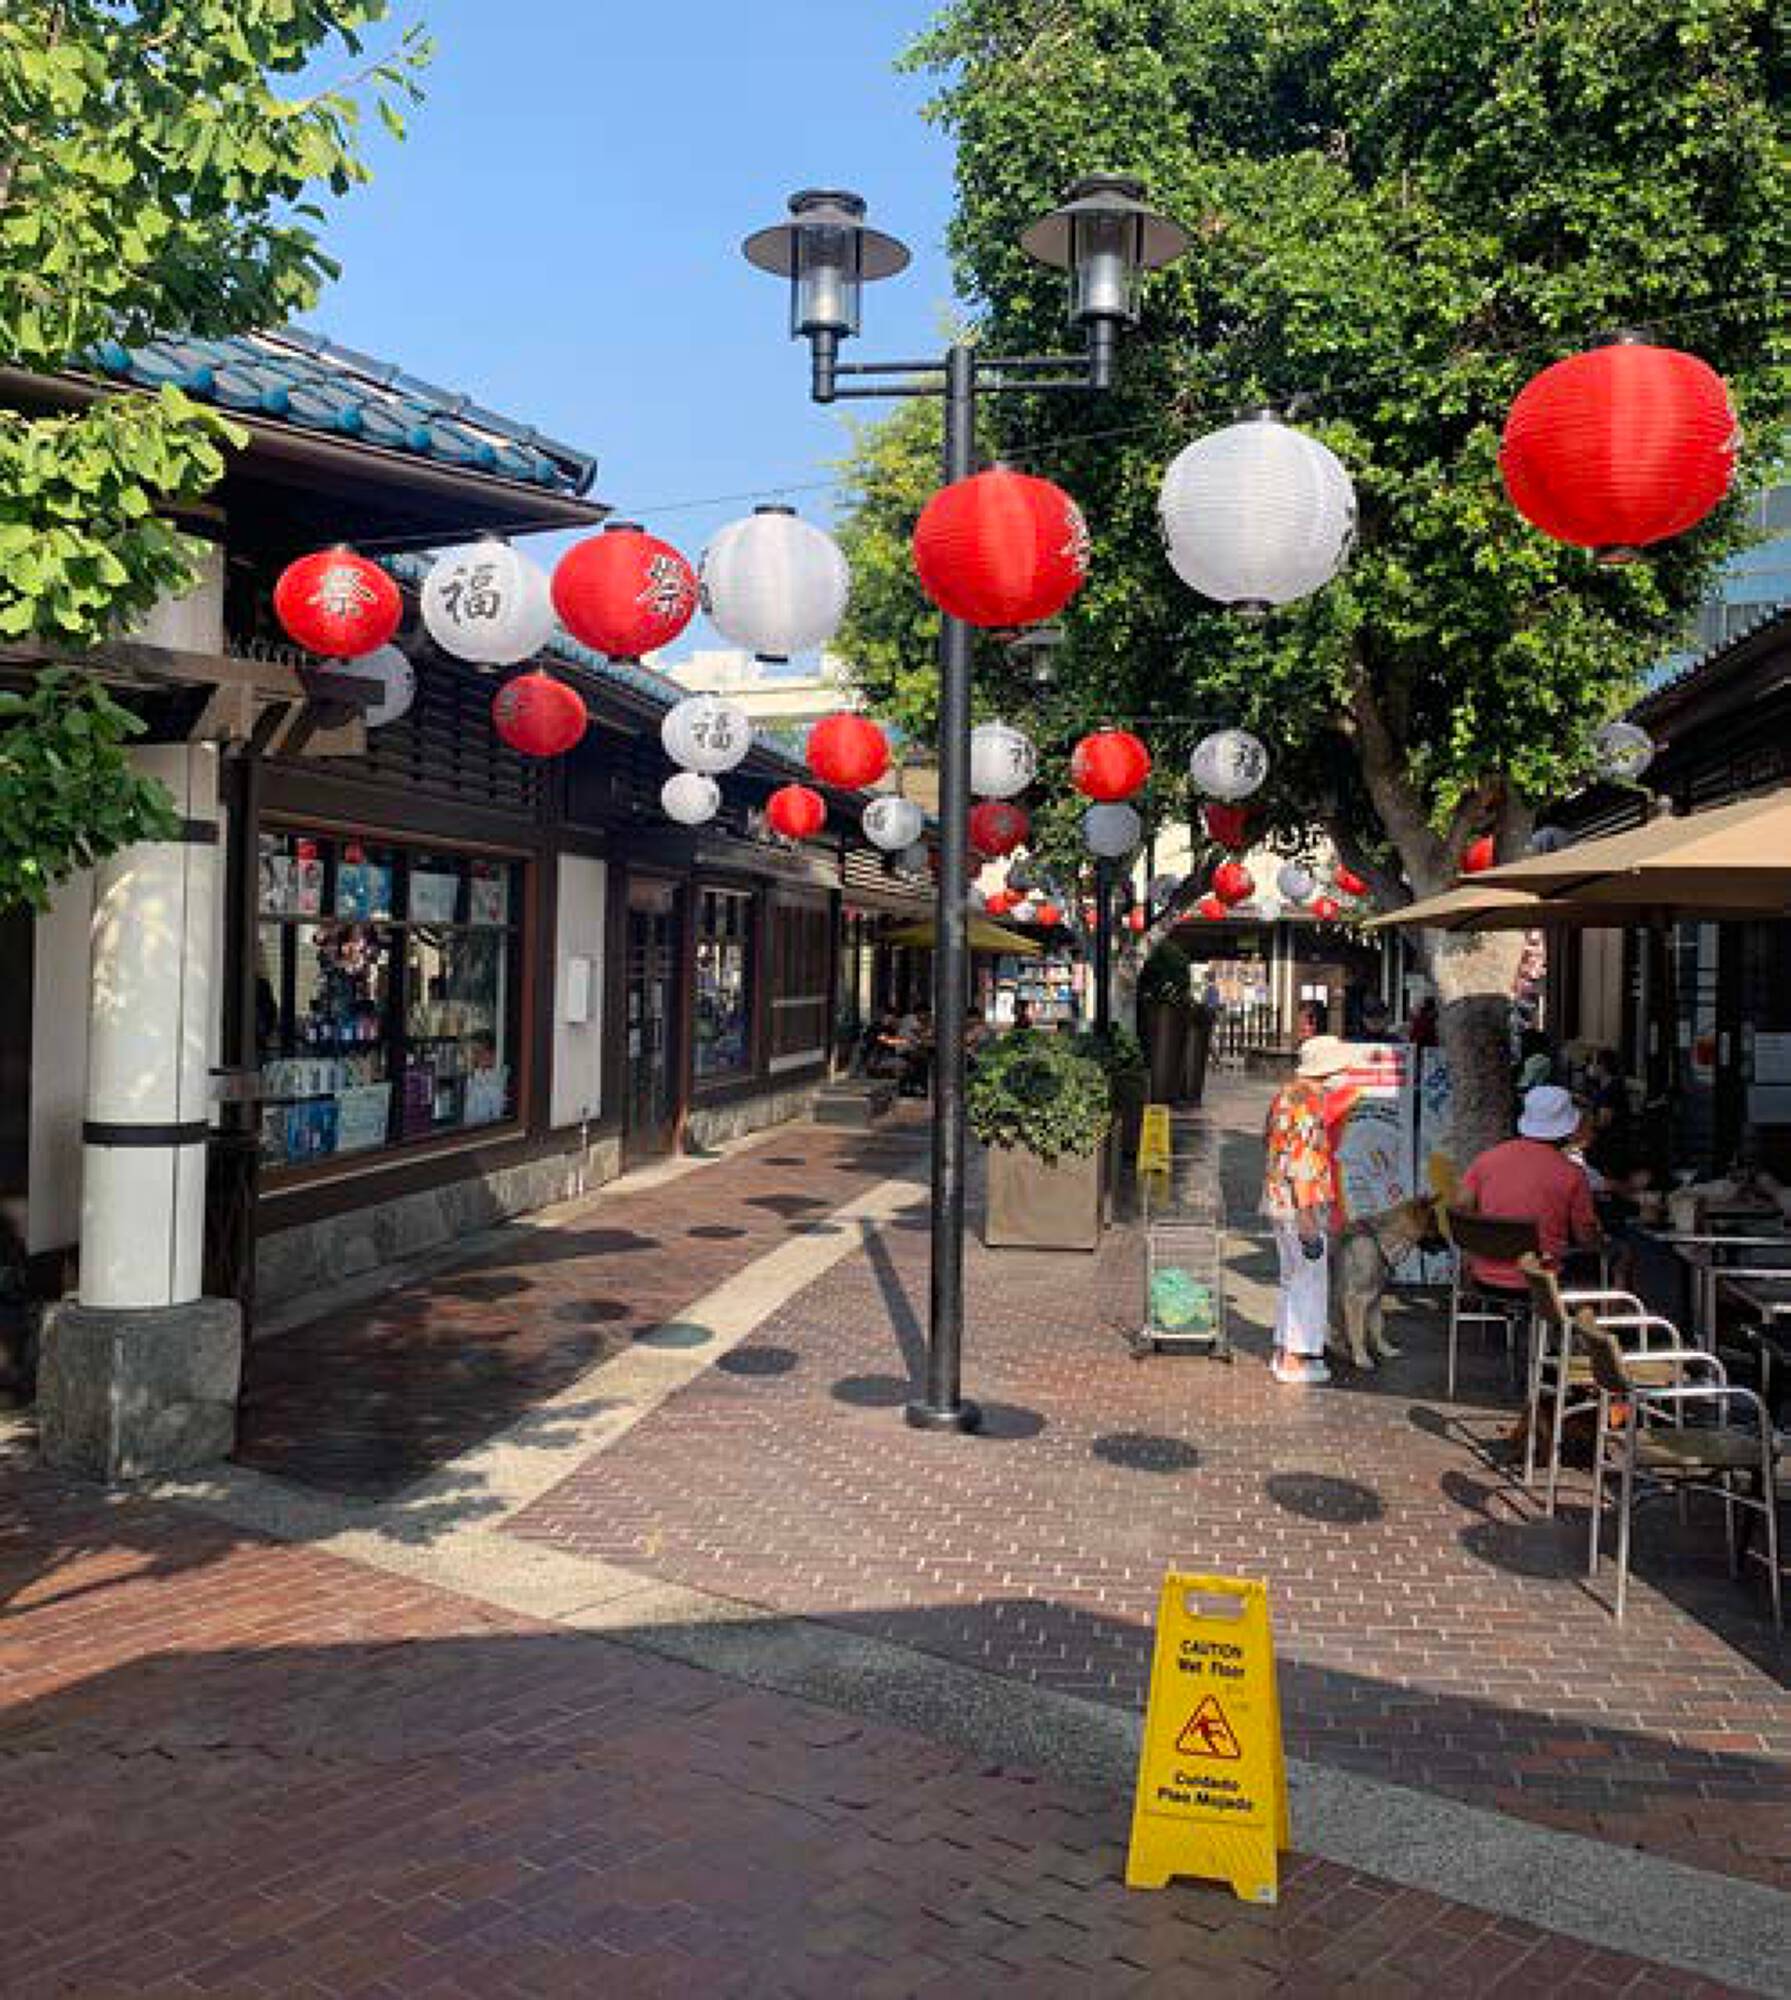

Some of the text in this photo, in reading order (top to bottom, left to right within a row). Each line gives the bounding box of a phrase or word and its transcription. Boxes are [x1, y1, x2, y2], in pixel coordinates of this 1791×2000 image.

[438, 563, 501, 627] 福
[1179, 1640, 1243, 1659] CAUTION
[1177, 1658, 1245, 1678] Wet Floor
[1175, 1769, 1239, 1791] Cuidado
[1157, 1786, 1253, 1813] Piso Mojado
